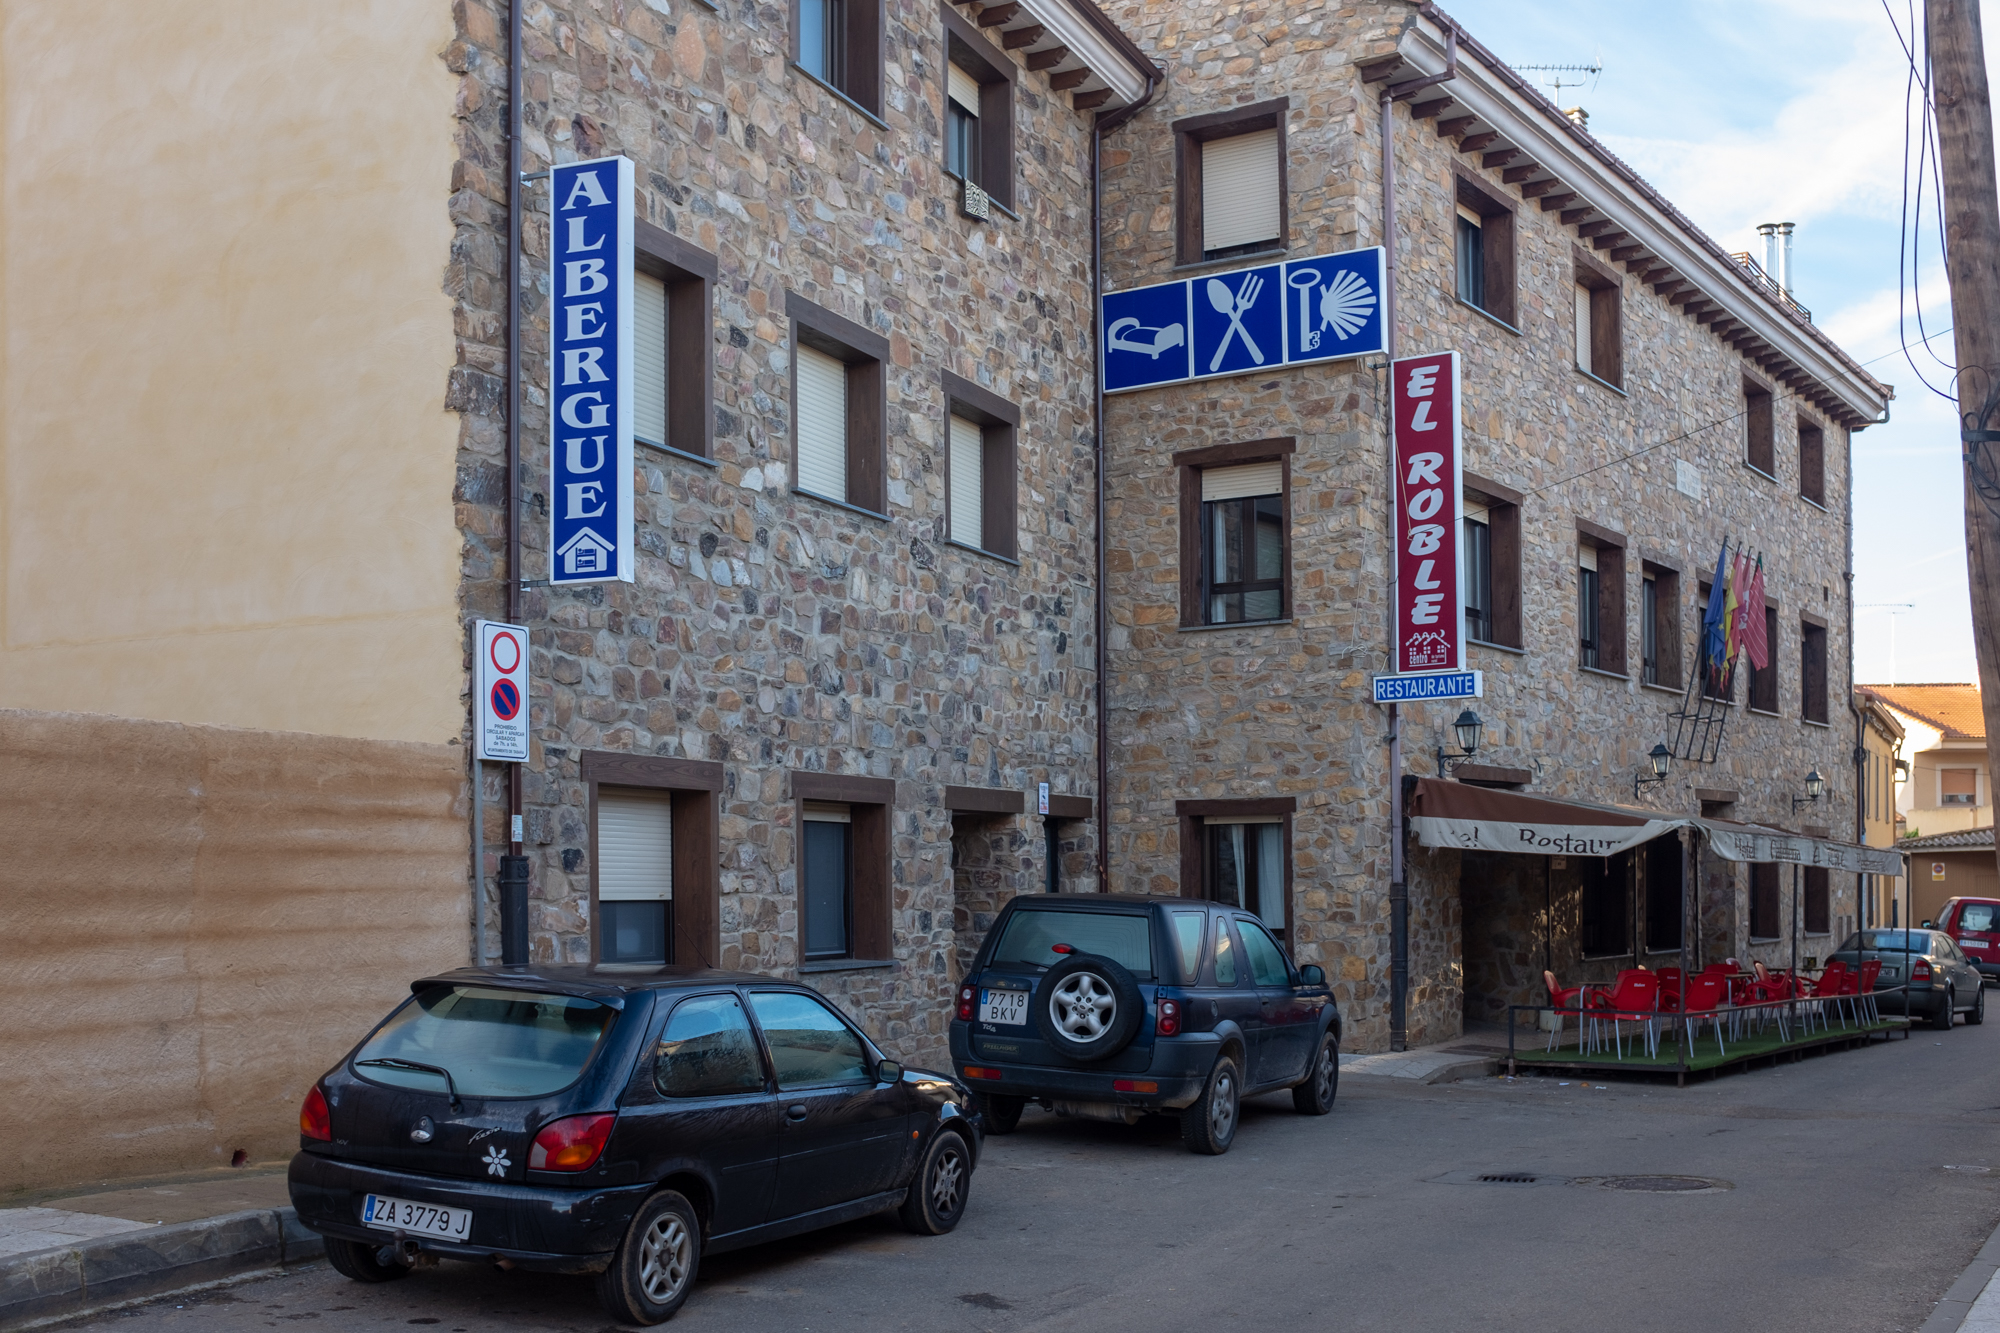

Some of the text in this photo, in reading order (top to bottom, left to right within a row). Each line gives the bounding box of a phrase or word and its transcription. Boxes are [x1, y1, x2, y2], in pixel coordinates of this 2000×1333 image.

[560, 170, 612, 520] ALBERGUE
[1407, 365, 1446, 626] EL ROBLE
[1409, 653, 1428, 665] centro
[1377, 676, 1473, 698] RESTAURANTE
[989, 993, 1025, 1008] 7718
[991, 1007, 1018, 1021] BKV
[982, 1023, 997, 1033] Td4
[374, 1200, 396, 1223] ZA
[402, 1204, 450, 1231] 3779
[455, 1213, 467, 1234] J
